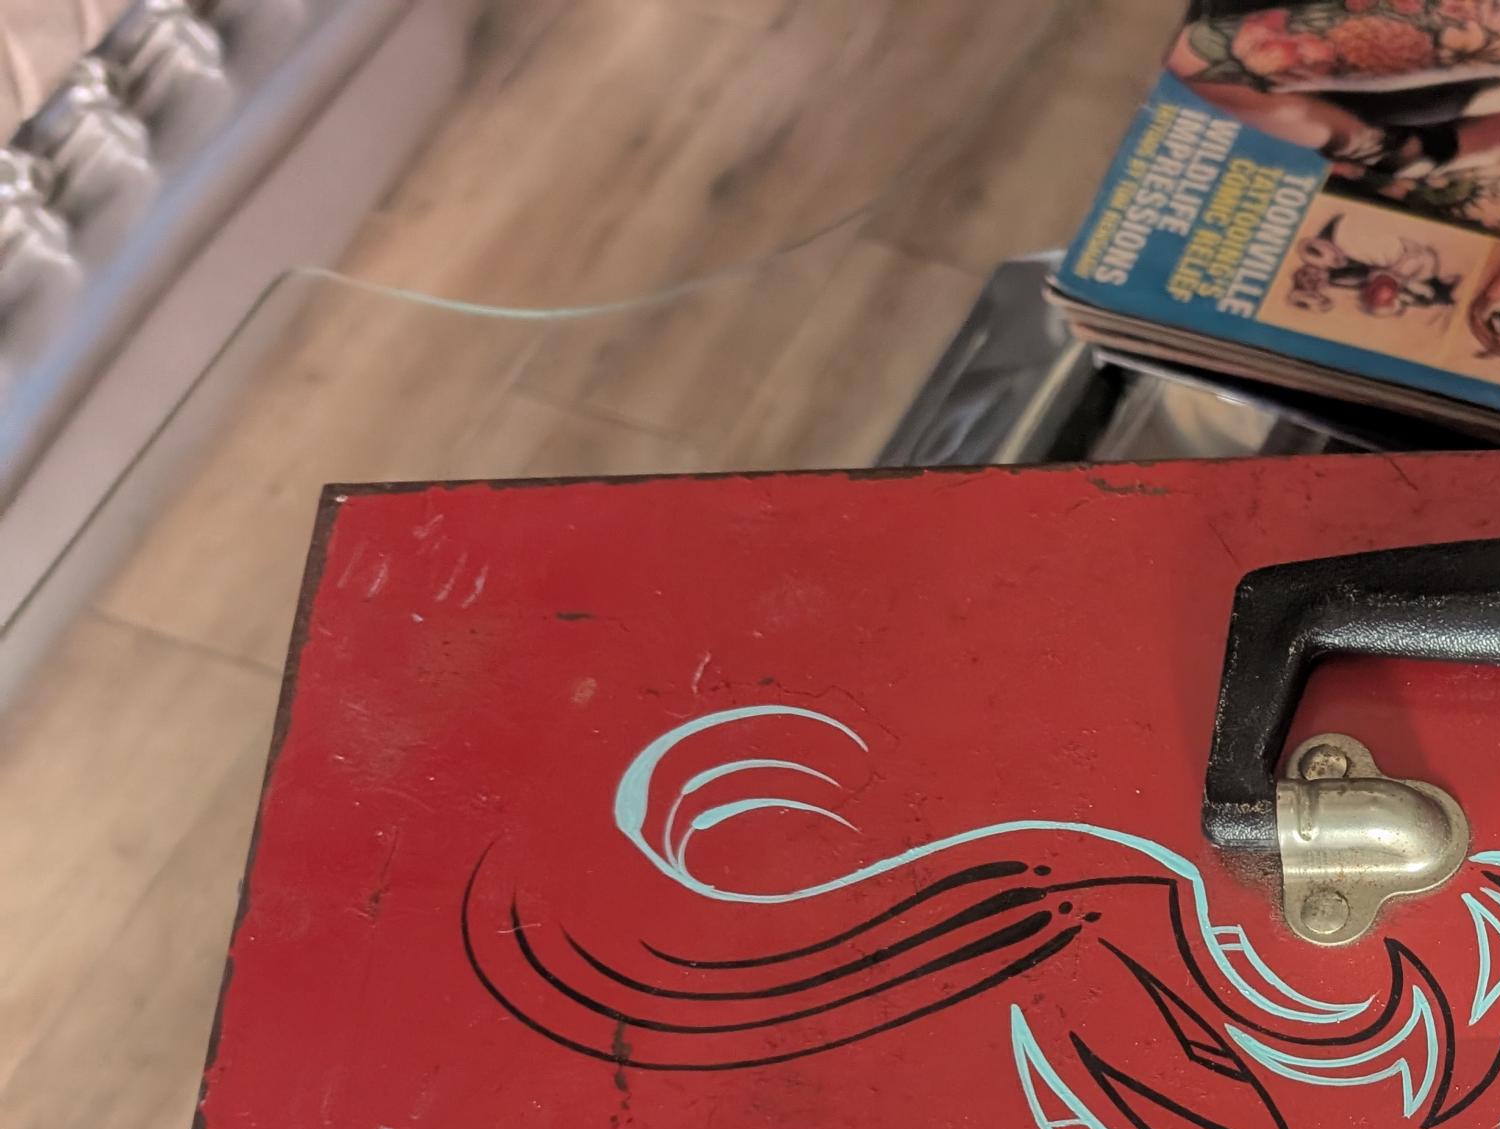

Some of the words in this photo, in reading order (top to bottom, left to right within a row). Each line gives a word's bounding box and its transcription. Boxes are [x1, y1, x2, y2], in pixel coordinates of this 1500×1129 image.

[1093, 107, 1211, 286] IMPRESSIONS
[1159, 118, 1243, 236] WILDLIFE
[1198, 166, 1286, 298] TATTOOING'S
[1204, 157, 1255, 227] COMIC
[1166, 228, 1224, 303] RELIEF
[1215, 173, 1317, 319] TOONVILLE
